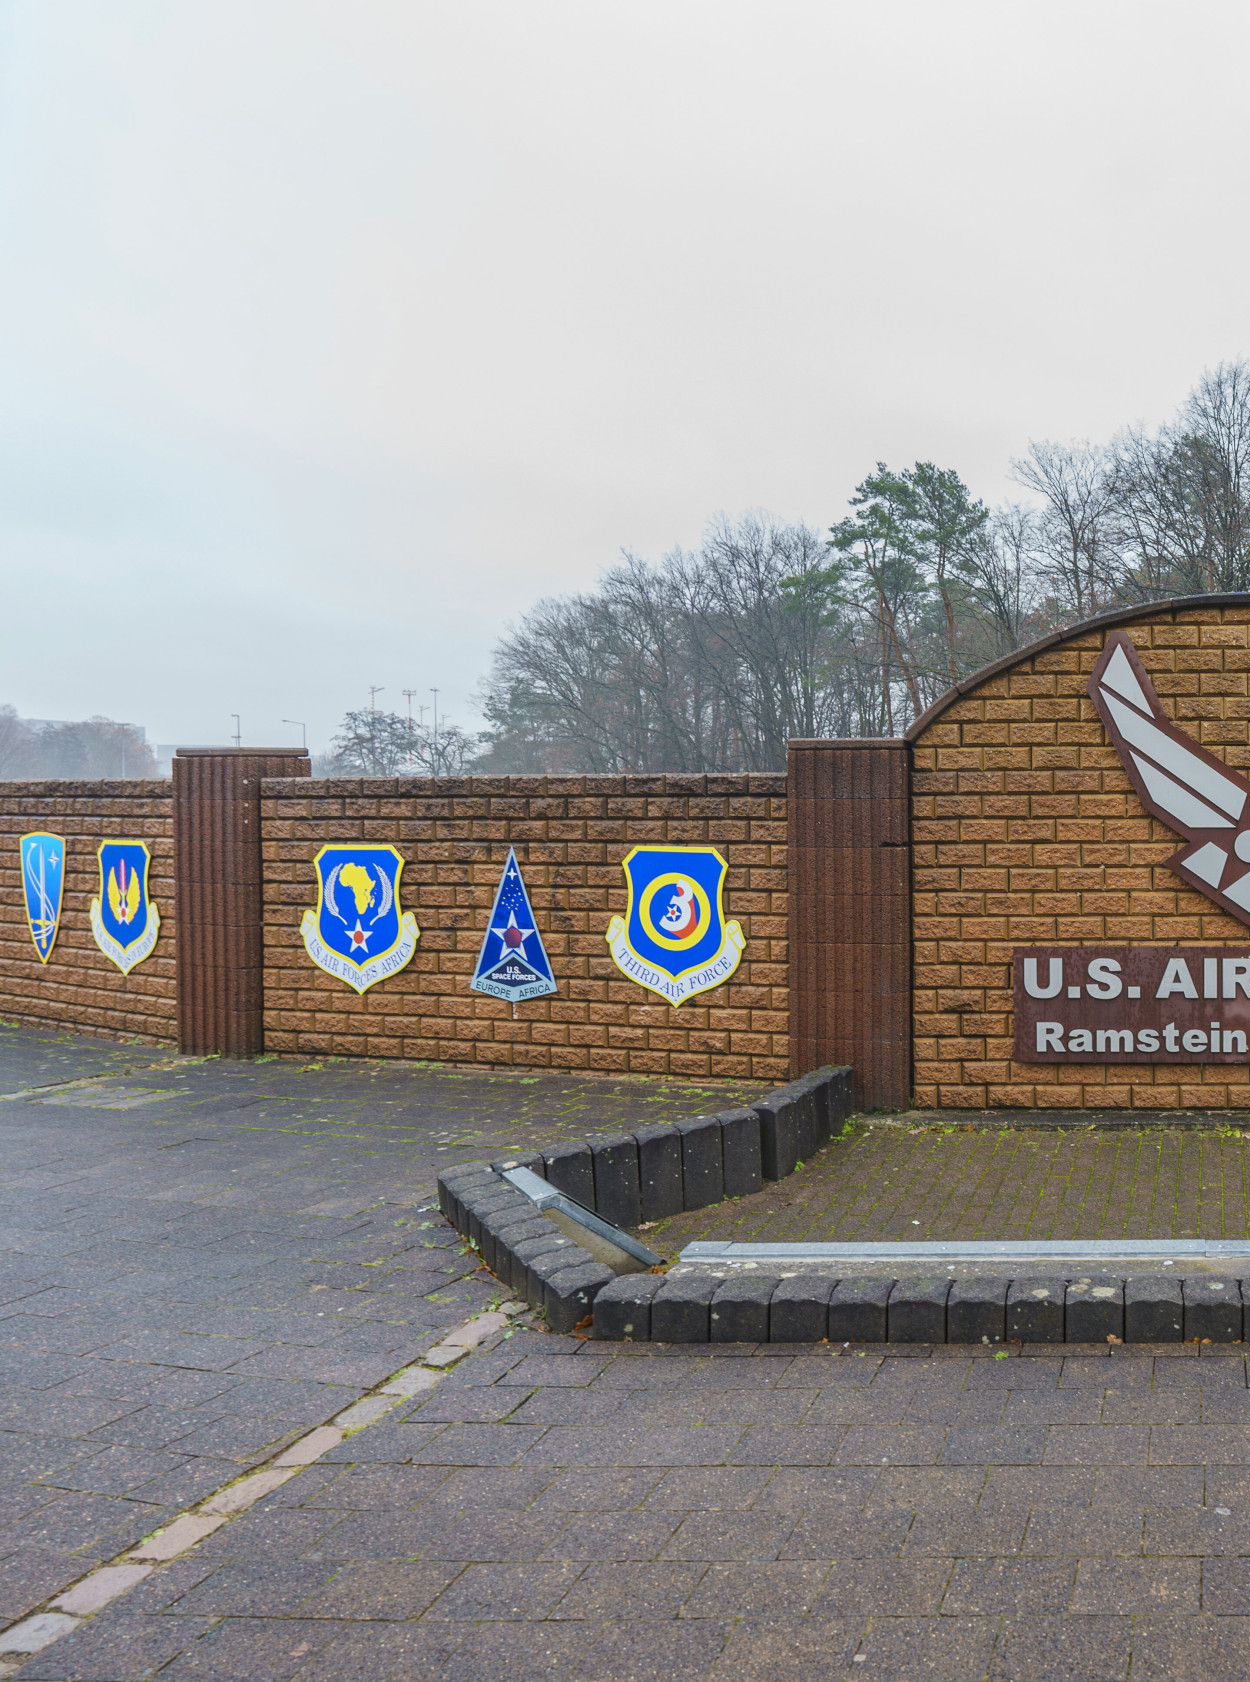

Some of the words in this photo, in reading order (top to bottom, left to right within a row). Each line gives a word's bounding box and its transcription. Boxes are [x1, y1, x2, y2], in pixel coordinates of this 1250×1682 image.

[321, 952, 340, 972] AIR
[342, 961, 378, 988] FORCES
[382, 941, 412, 975] AFRICA
[492, 972, 511, 981] SPACE
[511, 973, 537, 982] FORCES
[506, 966, 521, 974] U.S.
[618, 948, 660, 986] THIRD
[660, 982, 684, 998] AIR
[689, 956, 732, 989] FORCE
[1023, 957, 1142, 999] U.S.
[475, 980, 511, 999] EUROPE
[518, 983, 551, 999] AFRICA
[1036, 1021, 1248, 1054] Ramstein
